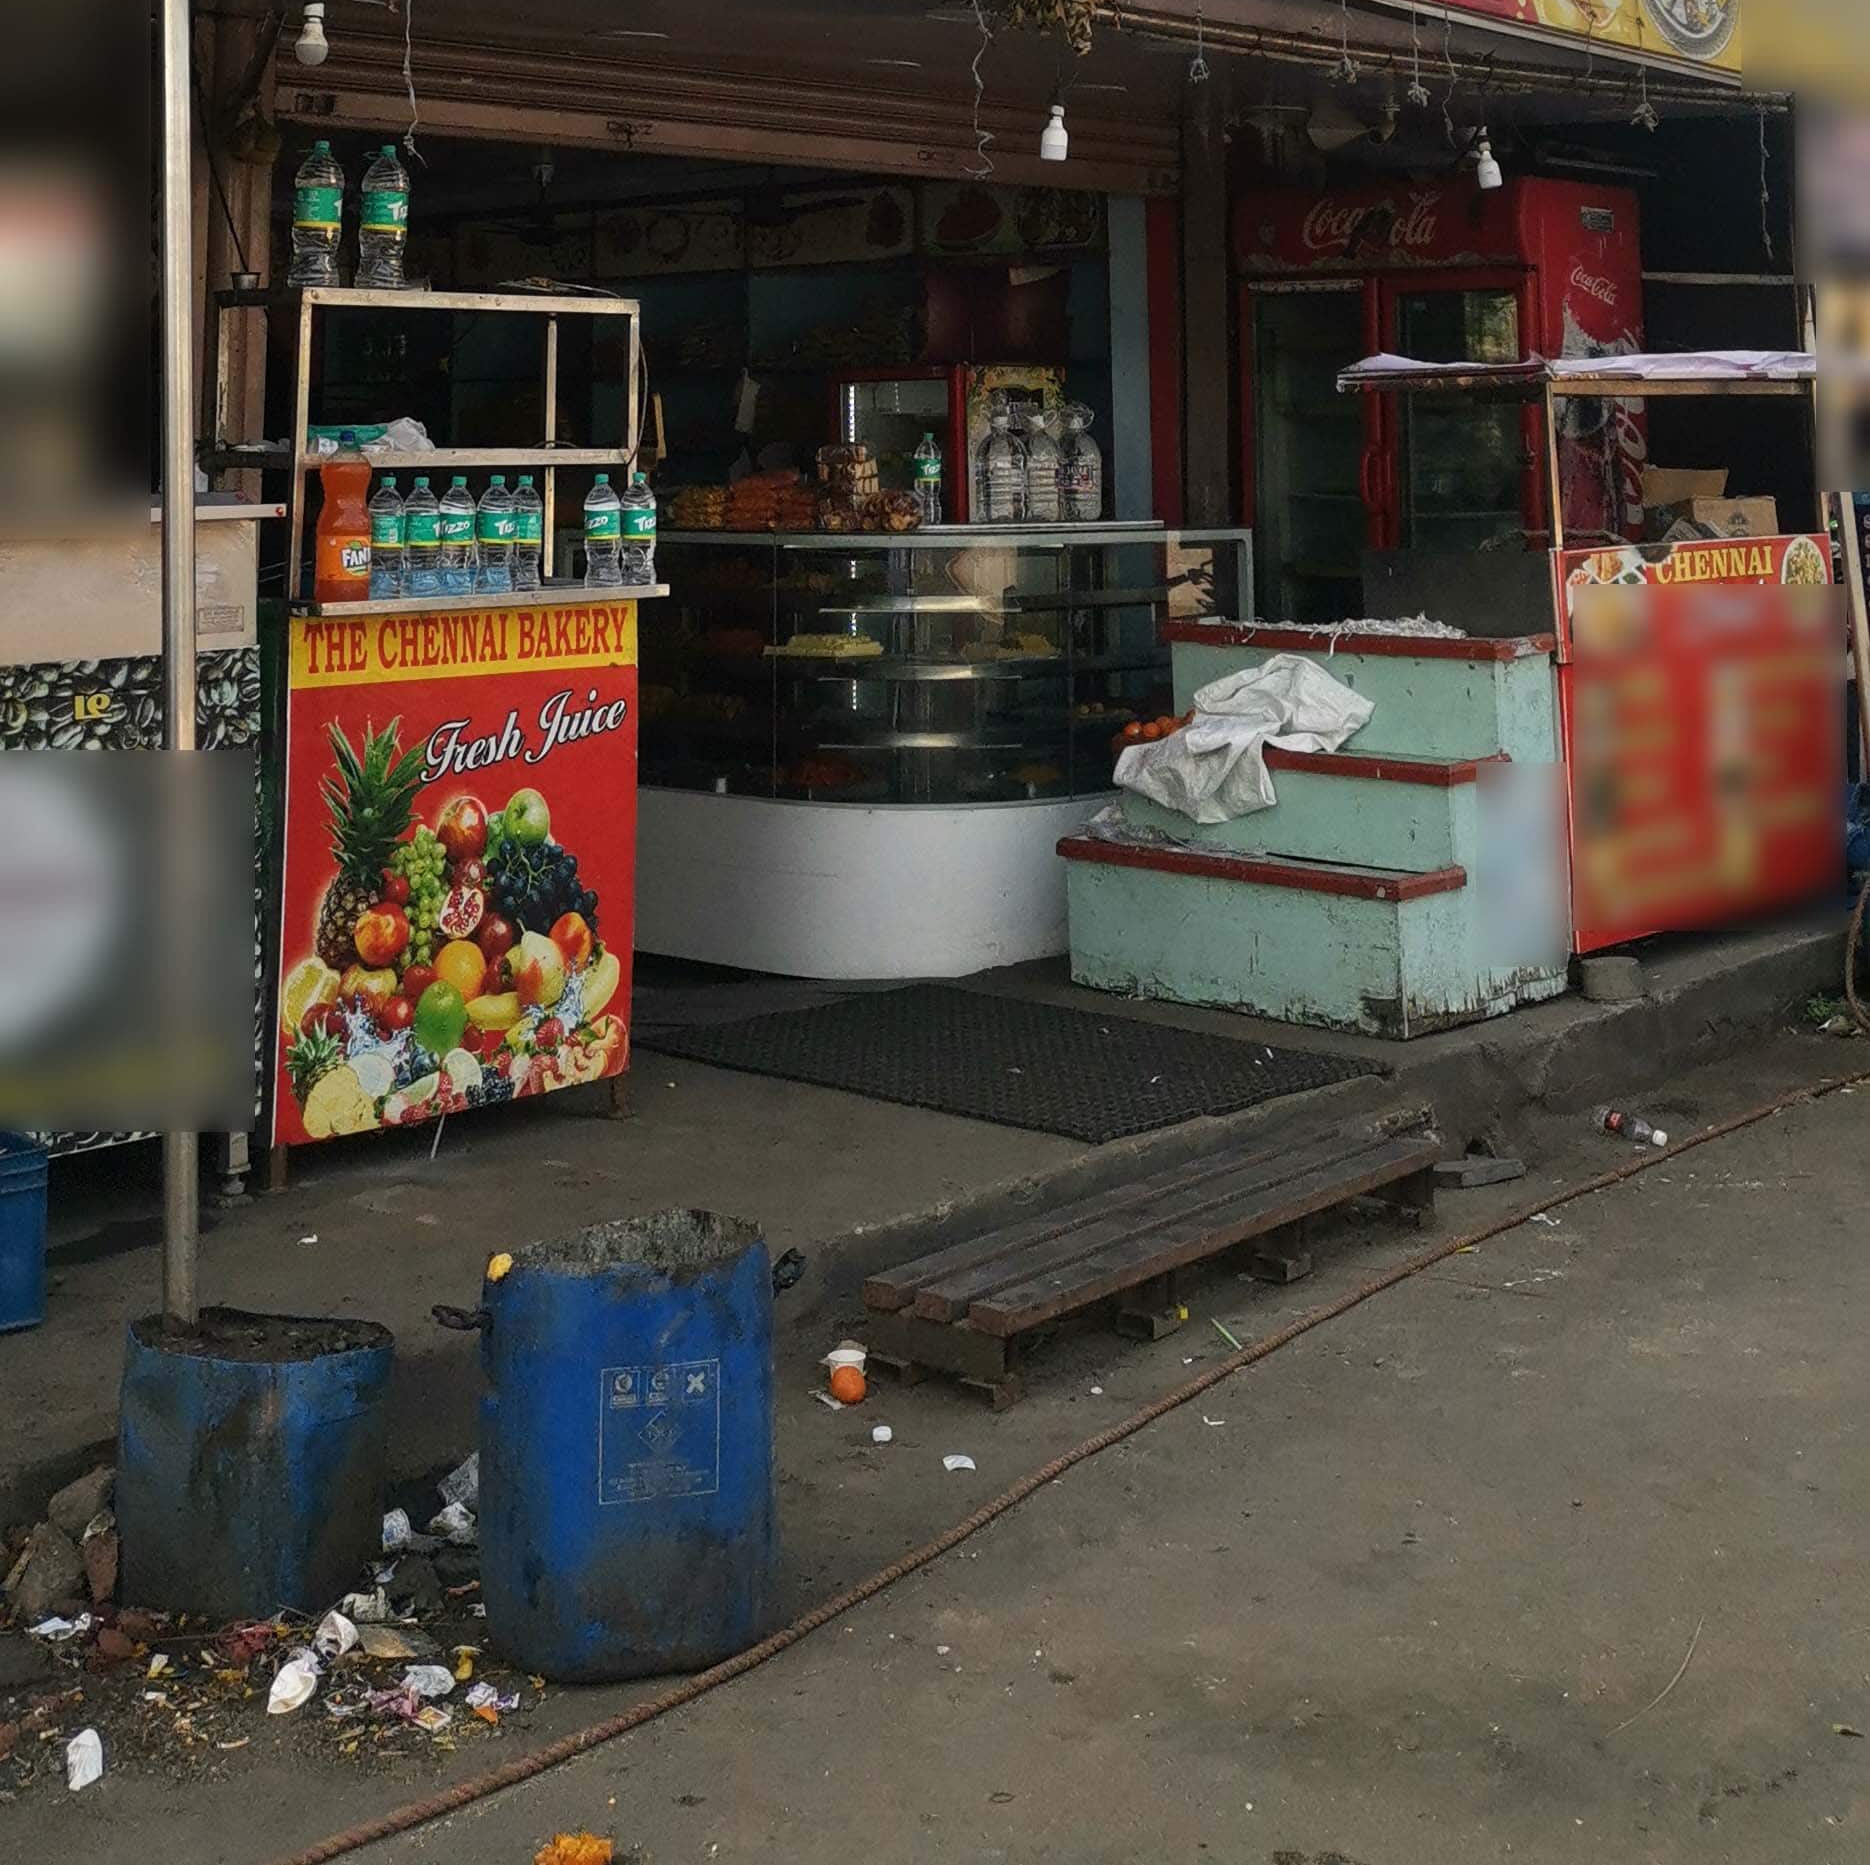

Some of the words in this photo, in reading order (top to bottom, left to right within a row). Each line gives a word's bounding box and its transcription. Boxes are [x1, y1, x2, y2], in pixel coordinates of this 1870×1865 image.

[303, 621, 368, 674] THE
[377, 613, 509, 669] CHENNAI
[517, 606, 628, 660] BAKERY
[420, 710, 525, 784] Fresh
[523, 688, 628, 765] Juice
